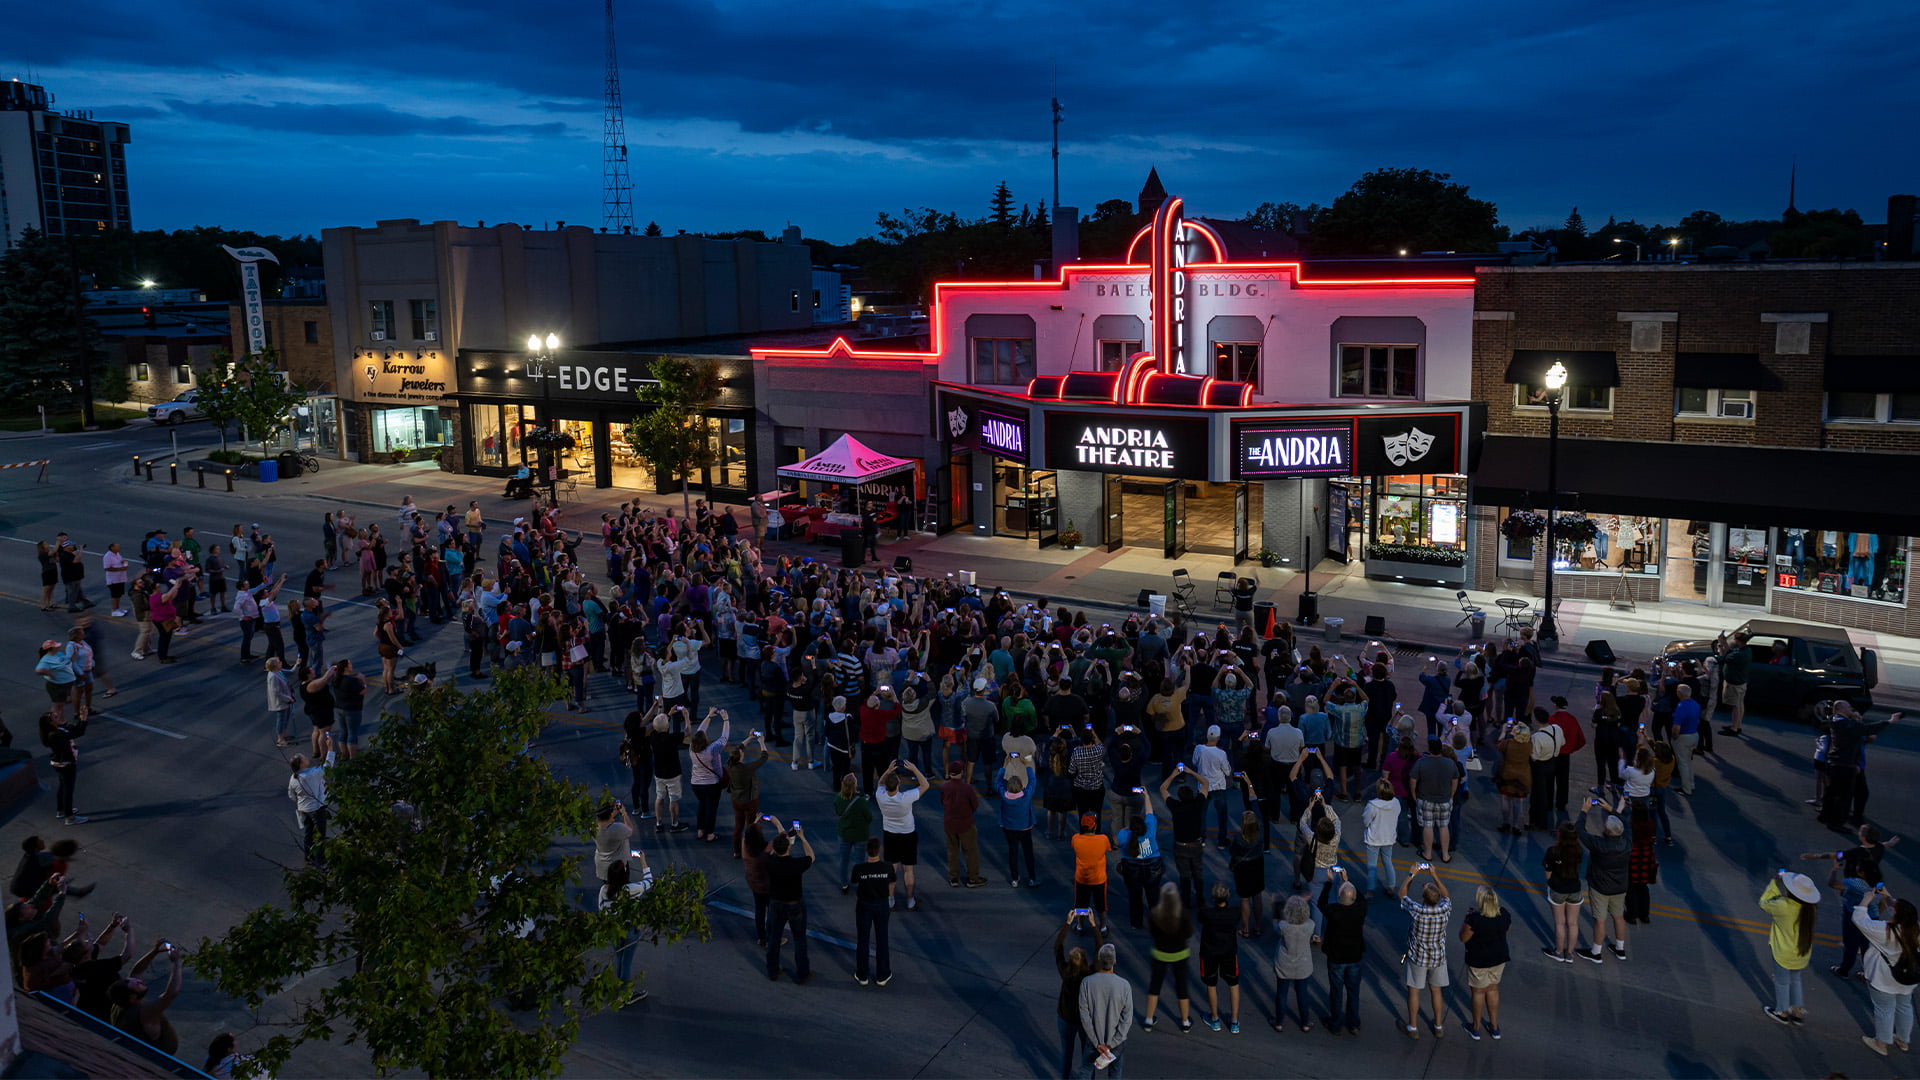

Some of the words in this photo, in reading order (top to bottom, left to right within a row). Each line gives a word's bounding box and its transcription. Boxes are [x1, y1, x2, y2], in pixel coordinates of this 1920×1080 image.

[1174, 218, 1185, 373] ANDRIA
[1199, 284, 1265, 297] BLDG.
[367, 367, 375, 380] KJ
[383, 361, 425, 374] Karrow
[559, 365, 628, 392] EDGE
[400, 378, 445, 392] Jewelers
[986, 419, 1022, 452] ANDRIA
[1080, 426, 1168, 448] ANDRIA
[1075, 445, 1174, 468] THEATRE
[1248, 447, 1261, 456] THE
[1259, 436, 1342, 466] ANDRIA
